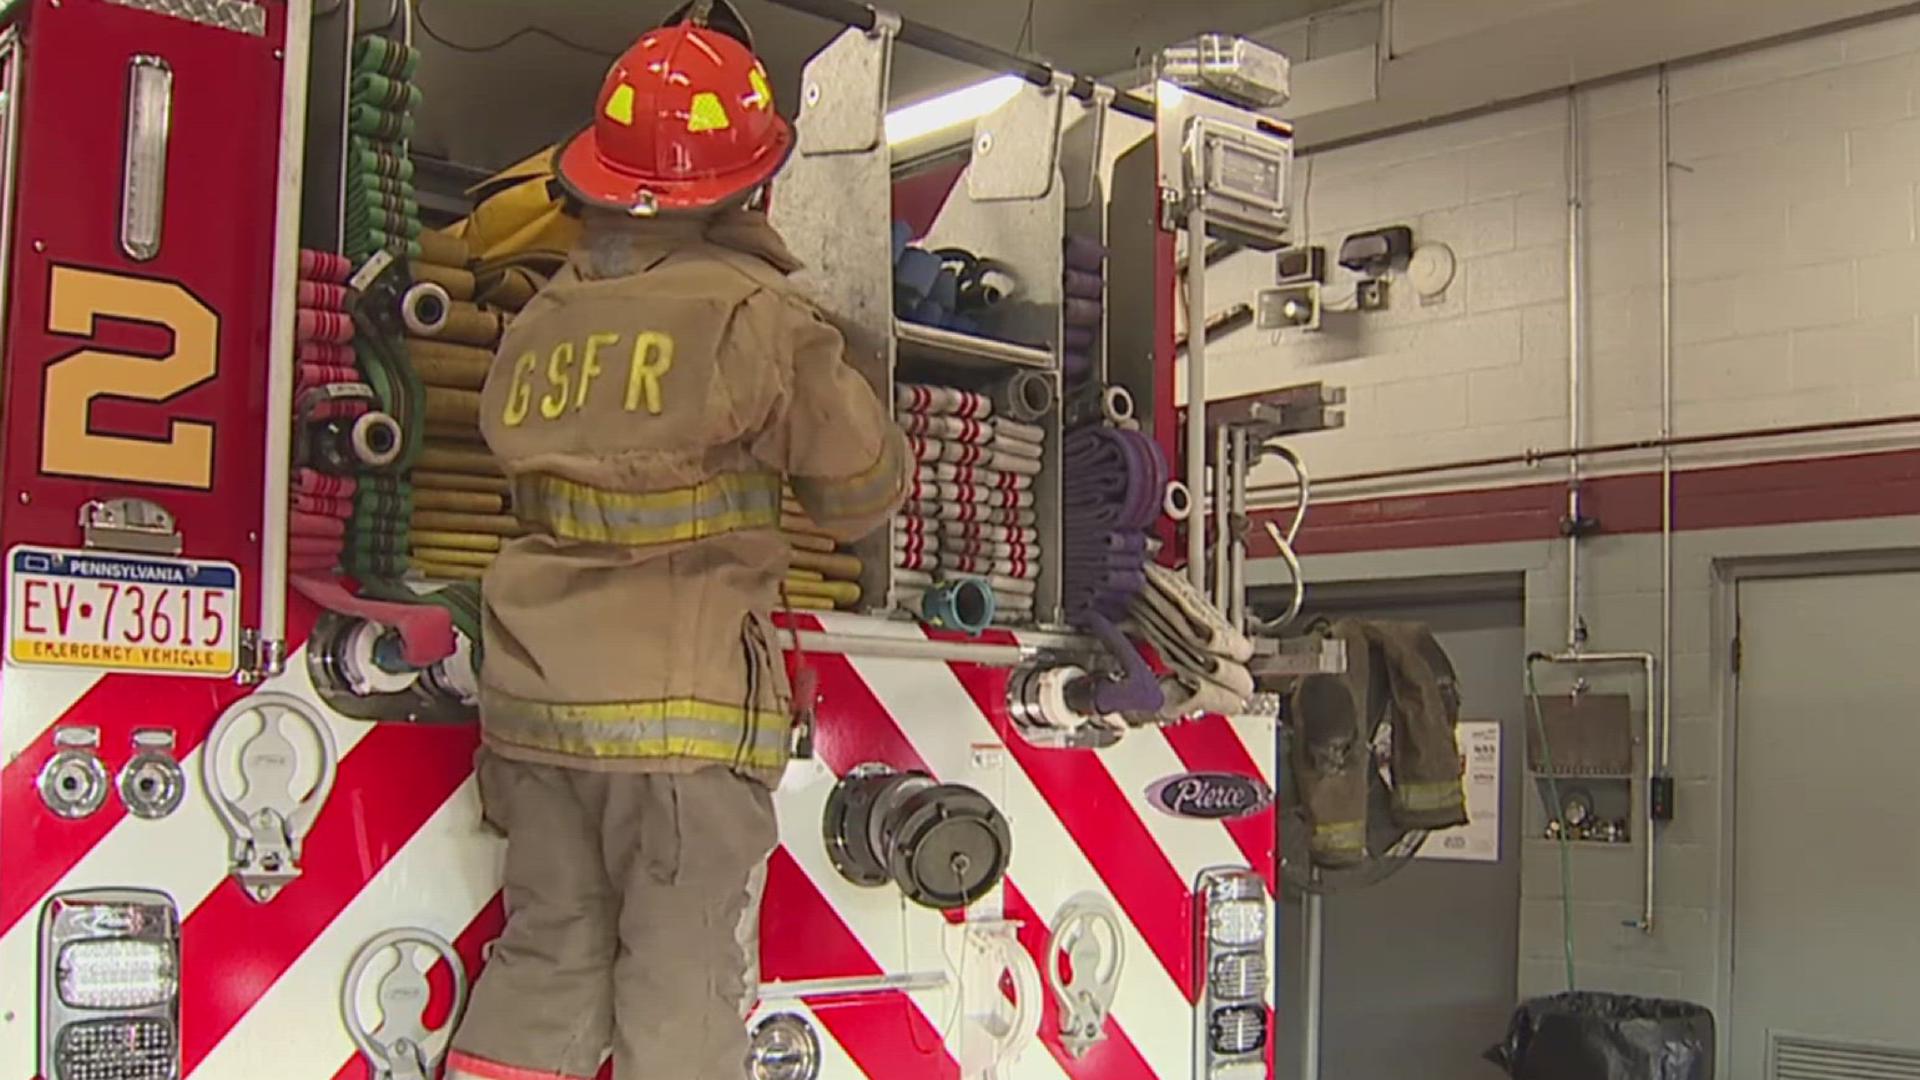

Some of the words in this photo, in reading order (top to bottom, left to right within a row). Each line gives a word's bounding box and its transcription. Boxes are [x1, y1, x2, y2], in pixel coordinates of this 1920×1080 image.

[39, 261, 221, 491] 2
[503, 331, 673, 426] GSFR
[69, 560, 184, 582] PENNSYLVANIA
[33, 641, 131, 660] EMERGENCY
[143, 650, 215, 667] VEHICLE
[1174, 779, 1245, 812] Pierce
